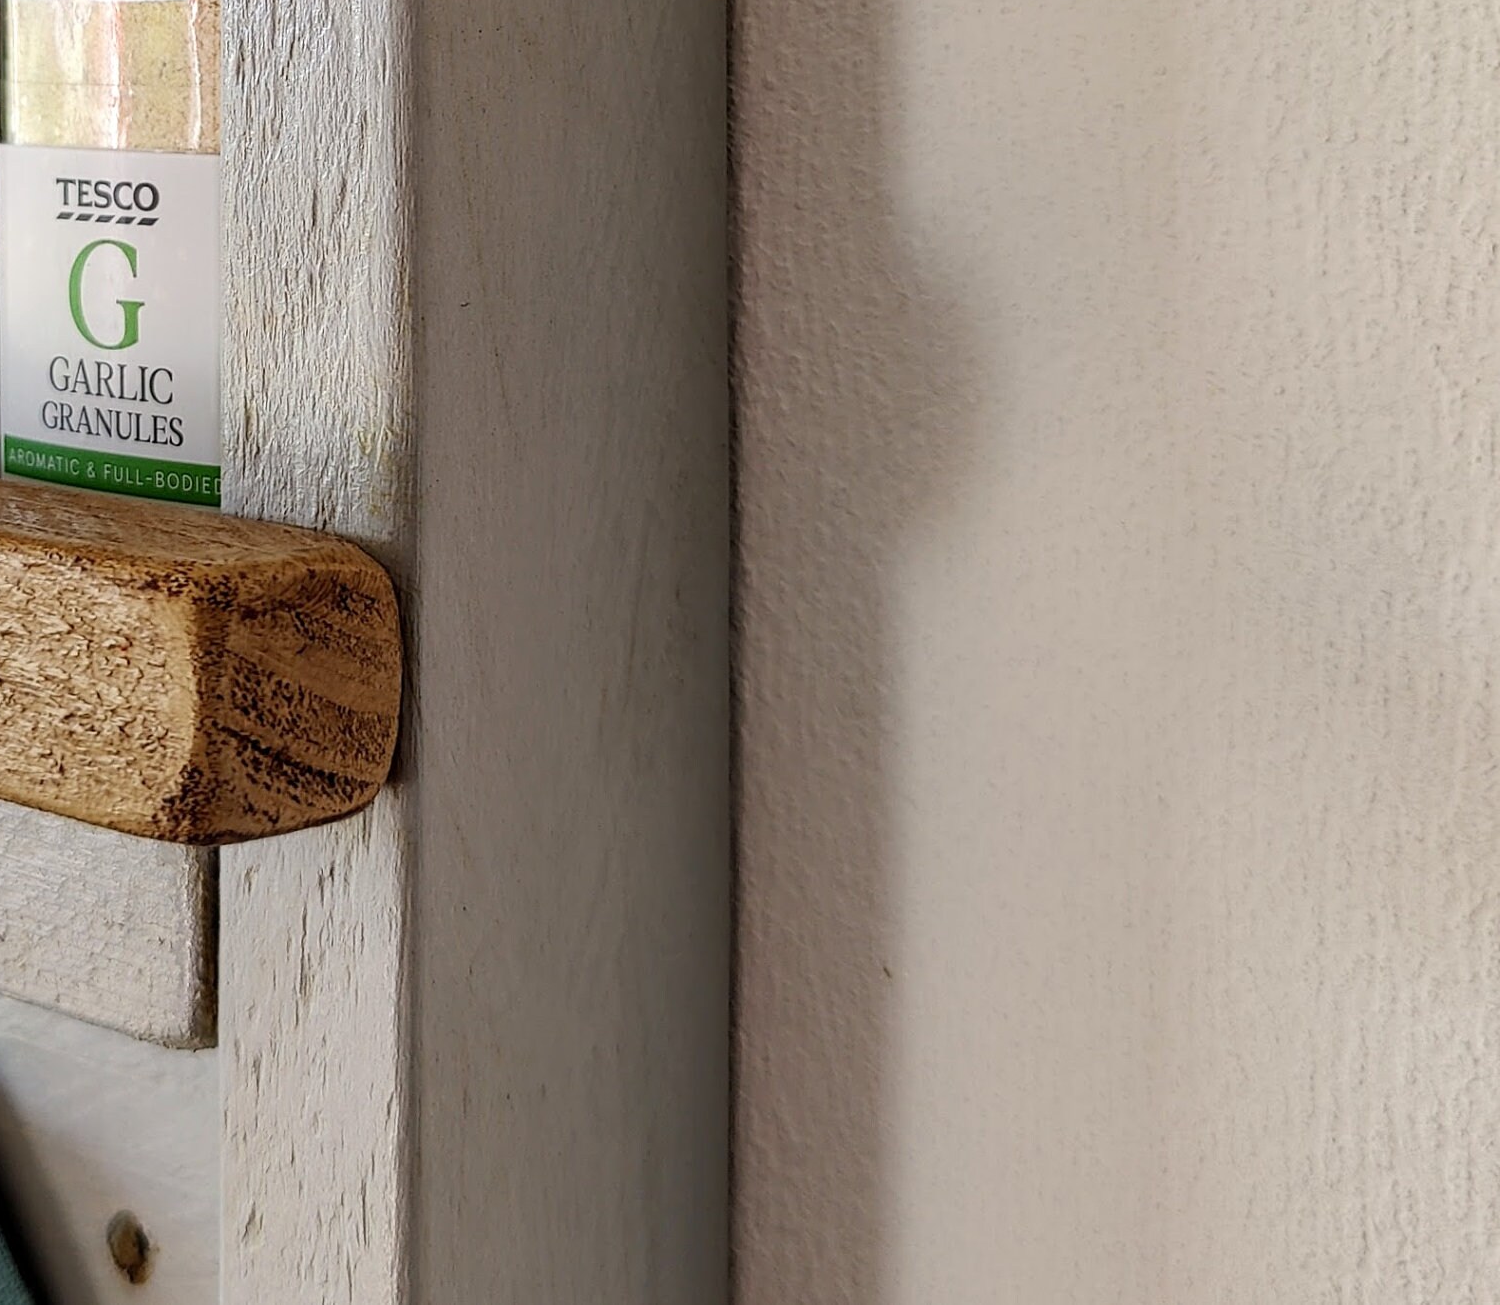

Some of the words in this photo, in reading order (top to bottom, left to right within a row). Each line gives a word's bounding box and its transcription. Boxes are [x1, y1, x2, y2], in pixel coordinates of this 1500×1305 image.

[56, 178, 160, 211] TESCO
[68, 239, 146, 351] G
[49, 355, 174, 404] GARLIC
[42, 399, 184, 448] GRANULES
[8, 447, 80, 476] AROMATIC
[86, 461, 96, 479] &
